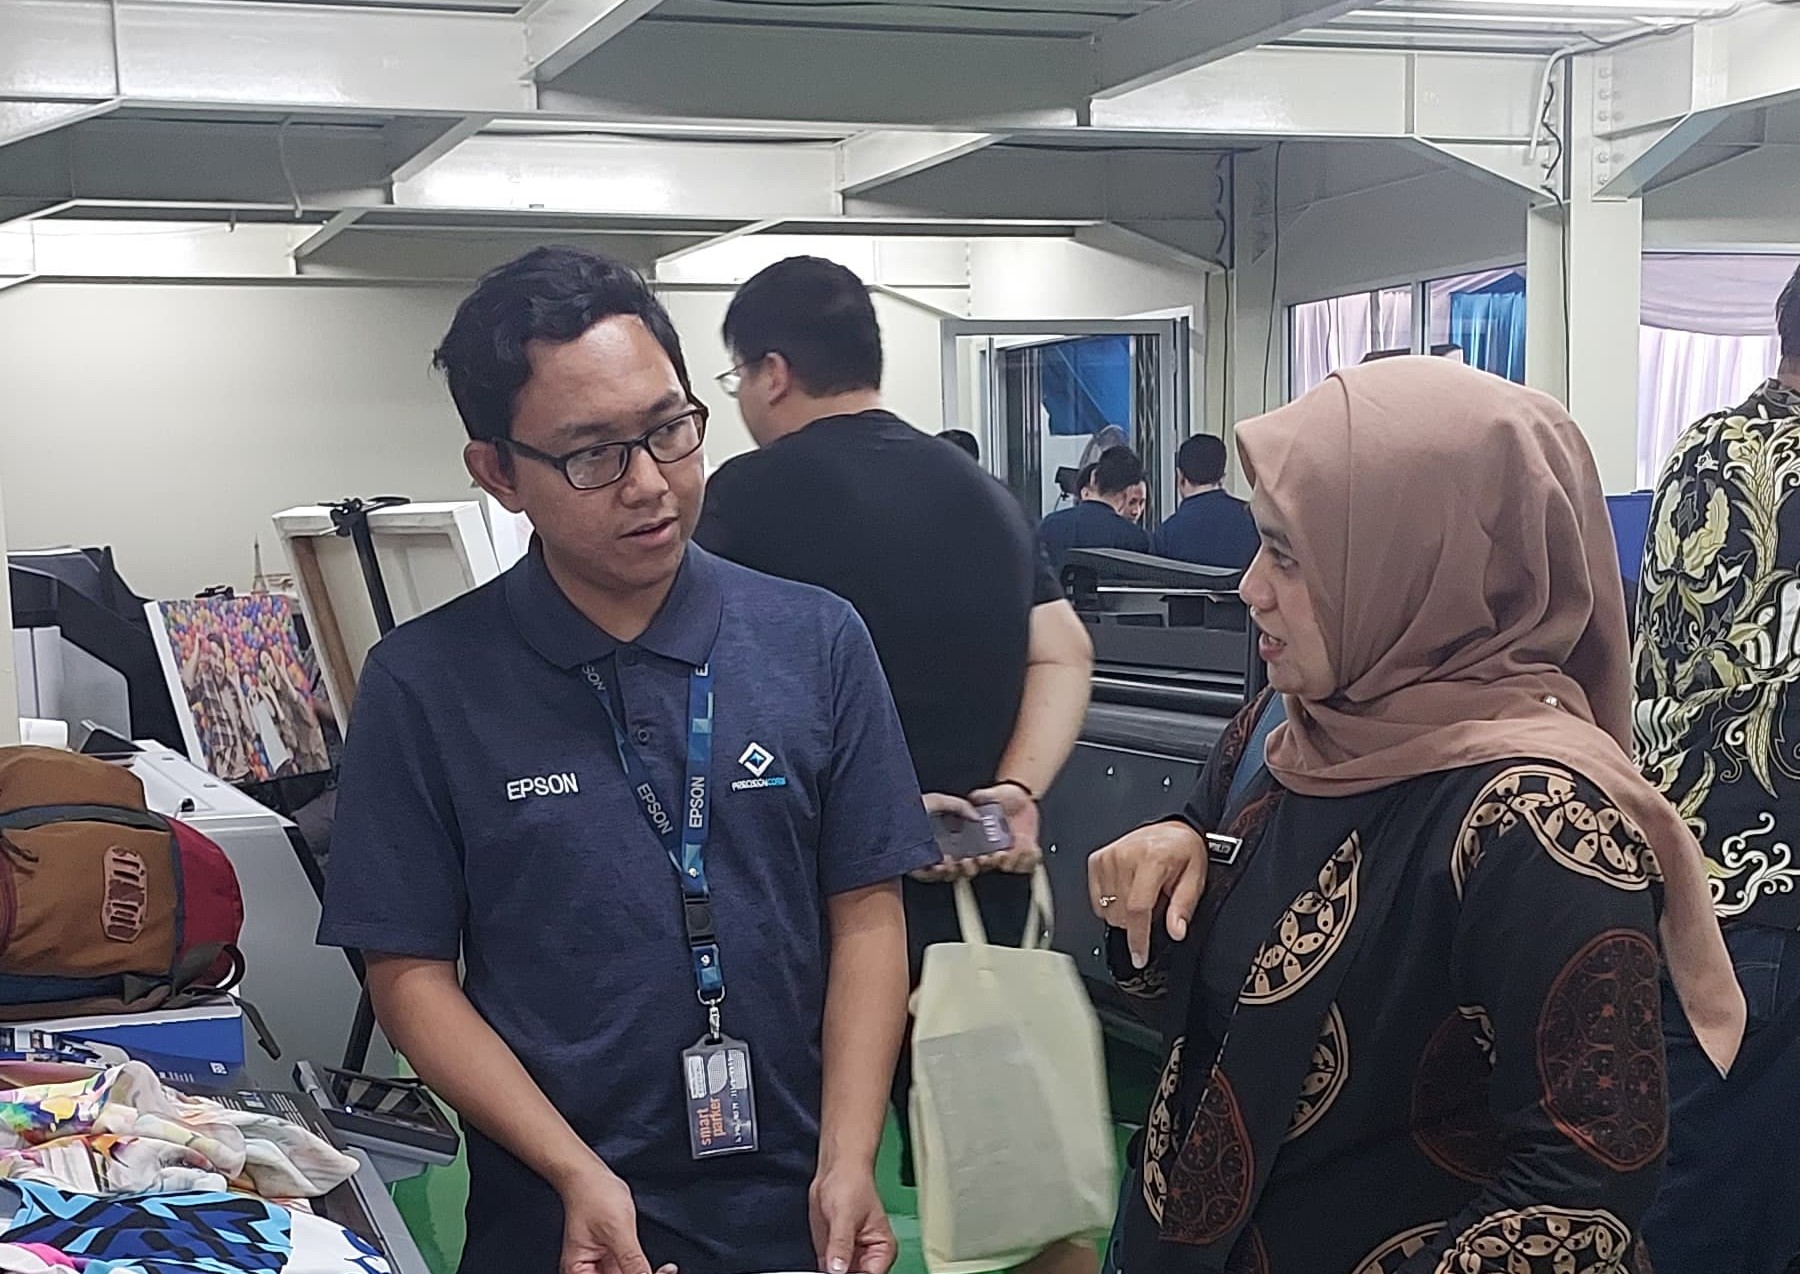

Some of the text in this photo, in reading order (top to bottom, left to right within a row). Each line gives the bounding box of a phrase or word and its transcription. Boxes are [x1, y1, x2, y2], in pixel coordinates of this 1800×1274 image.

[582, 664, 607, 691] SON
[507, 773, 579, 801] EPSON
[688, 776, 705, 828] EPSON
[636, 782, 674, 835] EPSON
[696, 1107, 712, 1147] smart
